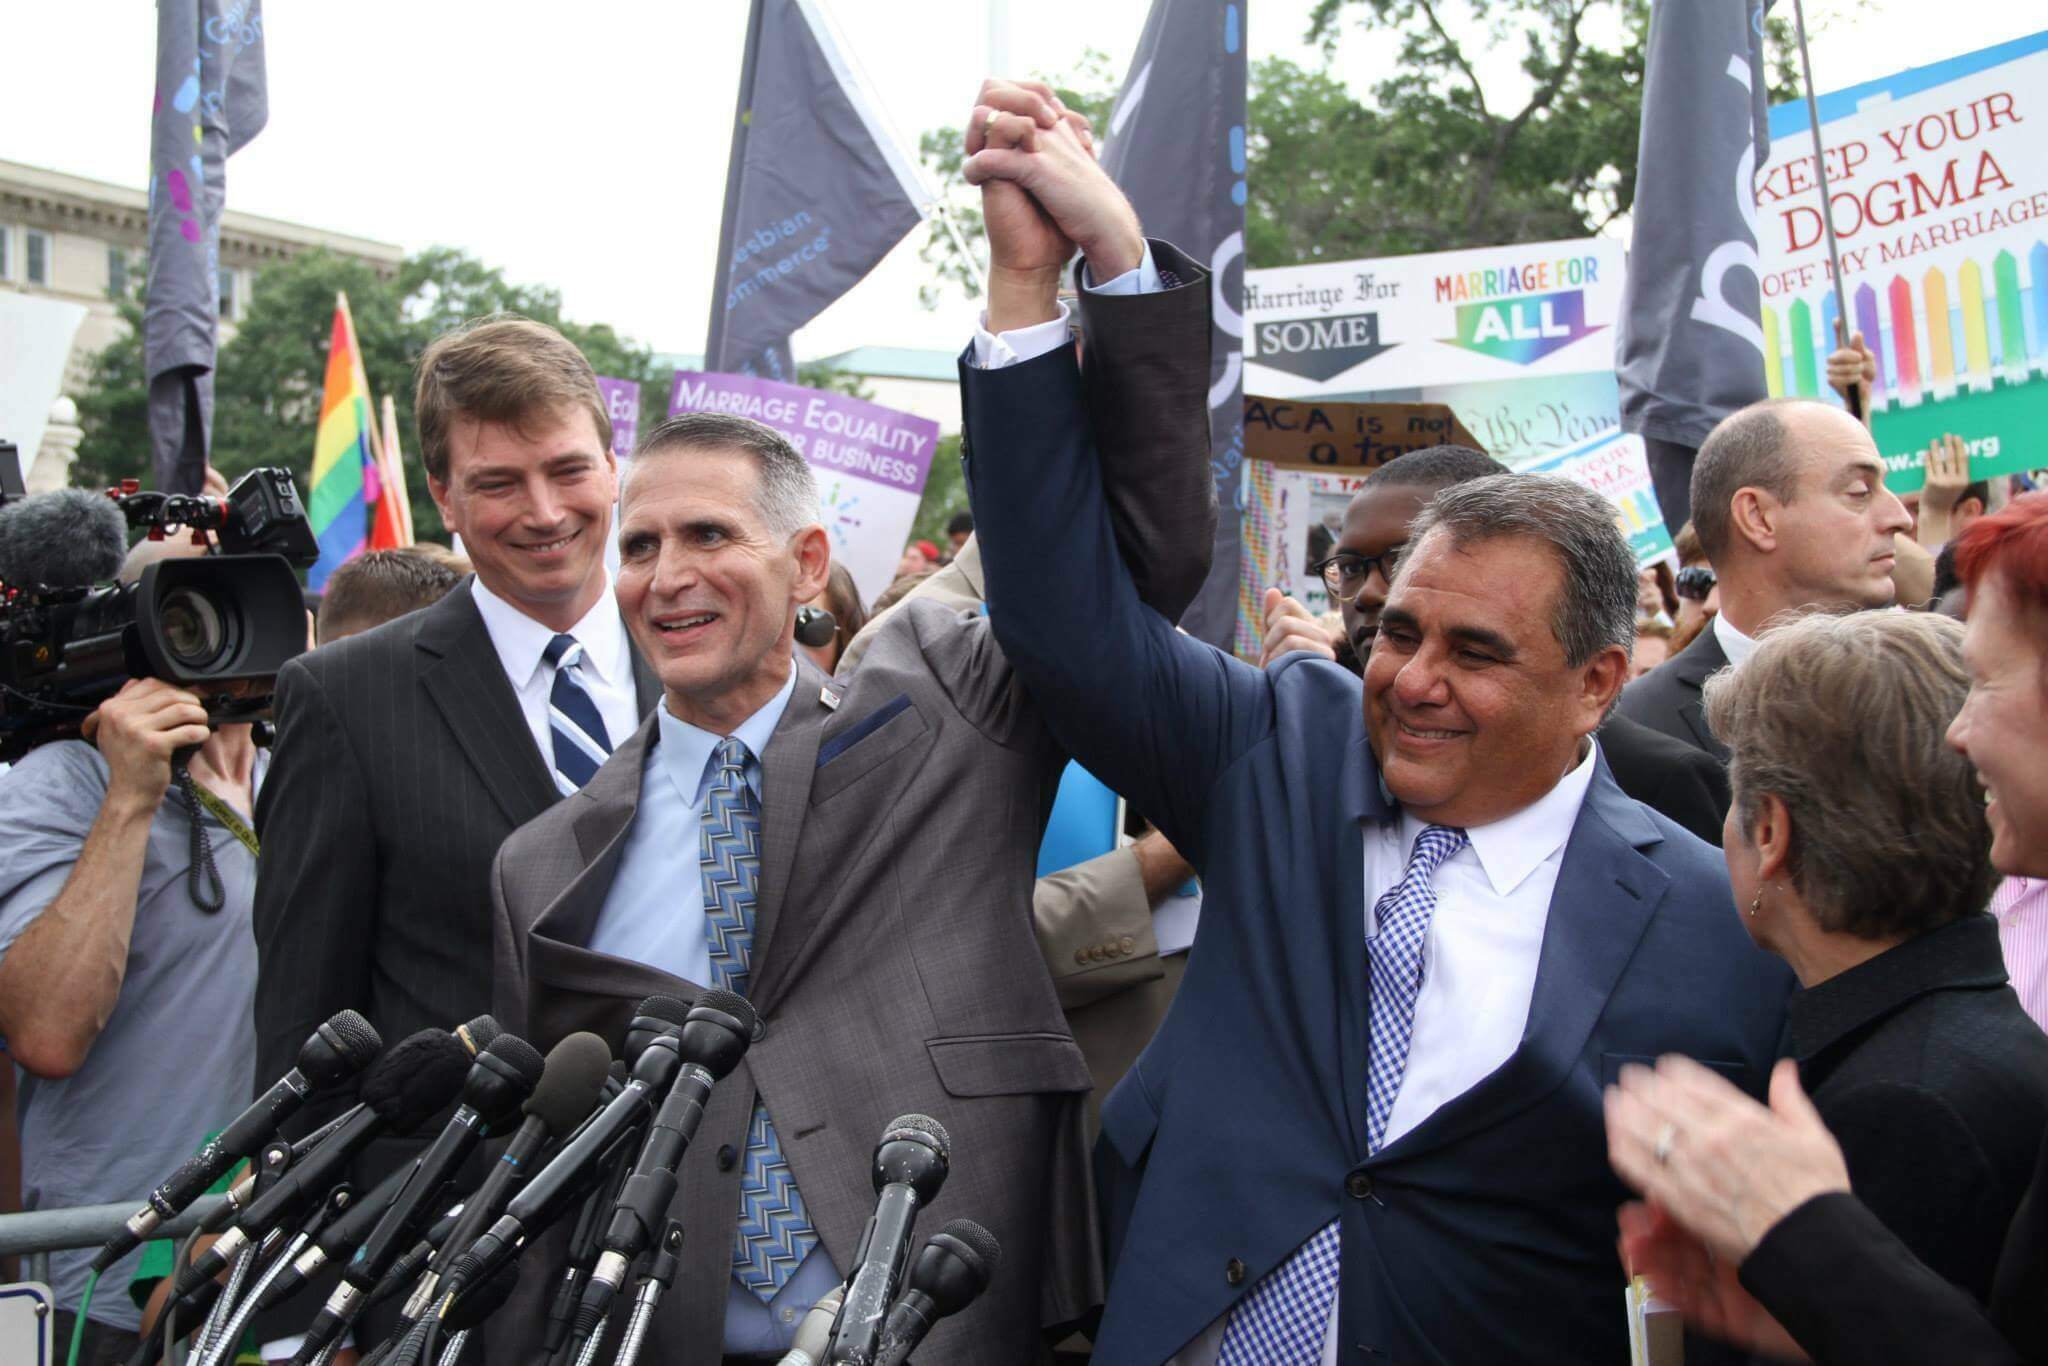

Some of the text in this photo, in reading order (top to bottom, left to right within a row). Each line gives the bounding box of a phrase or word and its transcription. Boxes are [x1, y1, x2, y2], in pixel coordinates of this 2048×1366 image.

[1755, 91, 2024, 207] KEEP YOUR
[1778, 148, 2015, 254] DOGMA
[731, 211, 812, 273] esbian
[1761, 191, 2048, 298] OFF MY MARRIAGE
[725, 235, 830, 311] ommerce
[1244, 273, 1401, 313] Marriage For
[1434, 255, 1599, 304] MARRIAGE FOR
[1261, 316, 1371, 355] SOME
[1472, 301, 1571, 344] ALL
[676, 380, 929, 456] MARRIAGE EQUALITY
[1244, 401, 1334, 433] ACA
[1355, 409, 1384, 434] is
[783, 431, 918, 486] OR BUSINESS
[1307, 435, 1429, 465] a ta
